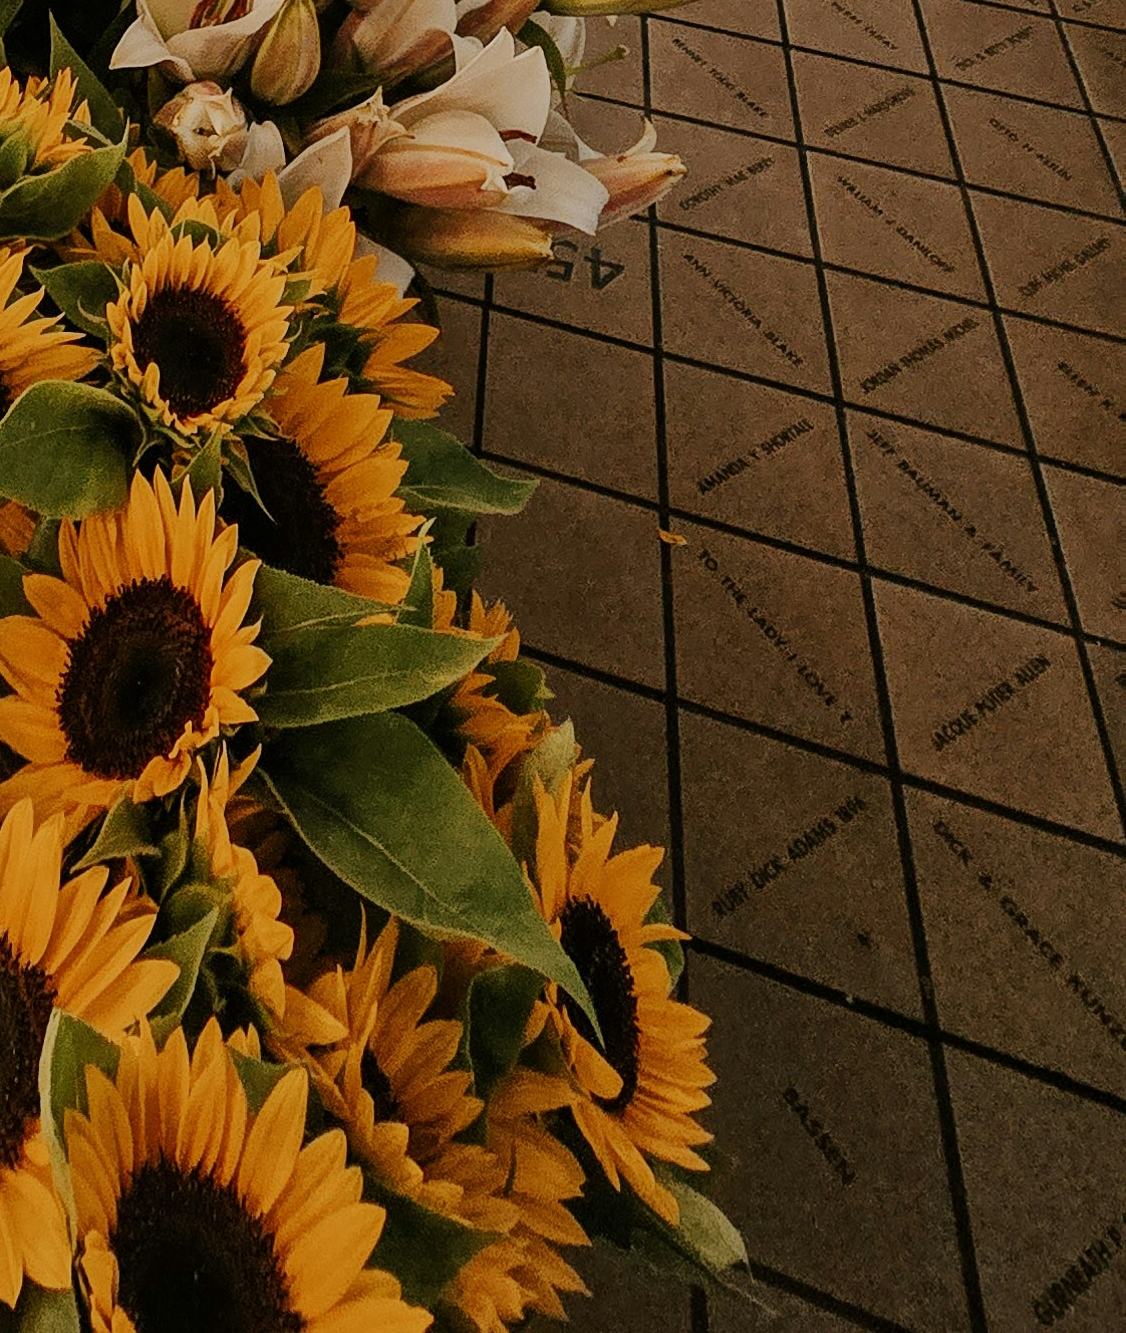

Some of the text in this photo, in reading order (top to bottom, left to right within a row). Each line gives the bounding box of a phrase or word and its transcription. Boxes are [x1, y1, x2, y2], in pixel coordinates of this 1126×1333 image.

[684, 254, 711, 276] ANN
[713, 282, 763, 327] VICTORIA
[695, 458, 749, 494] AMANDA
[697, 551, 719, 571] TO
[720, 577, 747, 603] THE
[798, 665, 836, 705] LOVE
[784, 817, 837, 862] ADAMS
